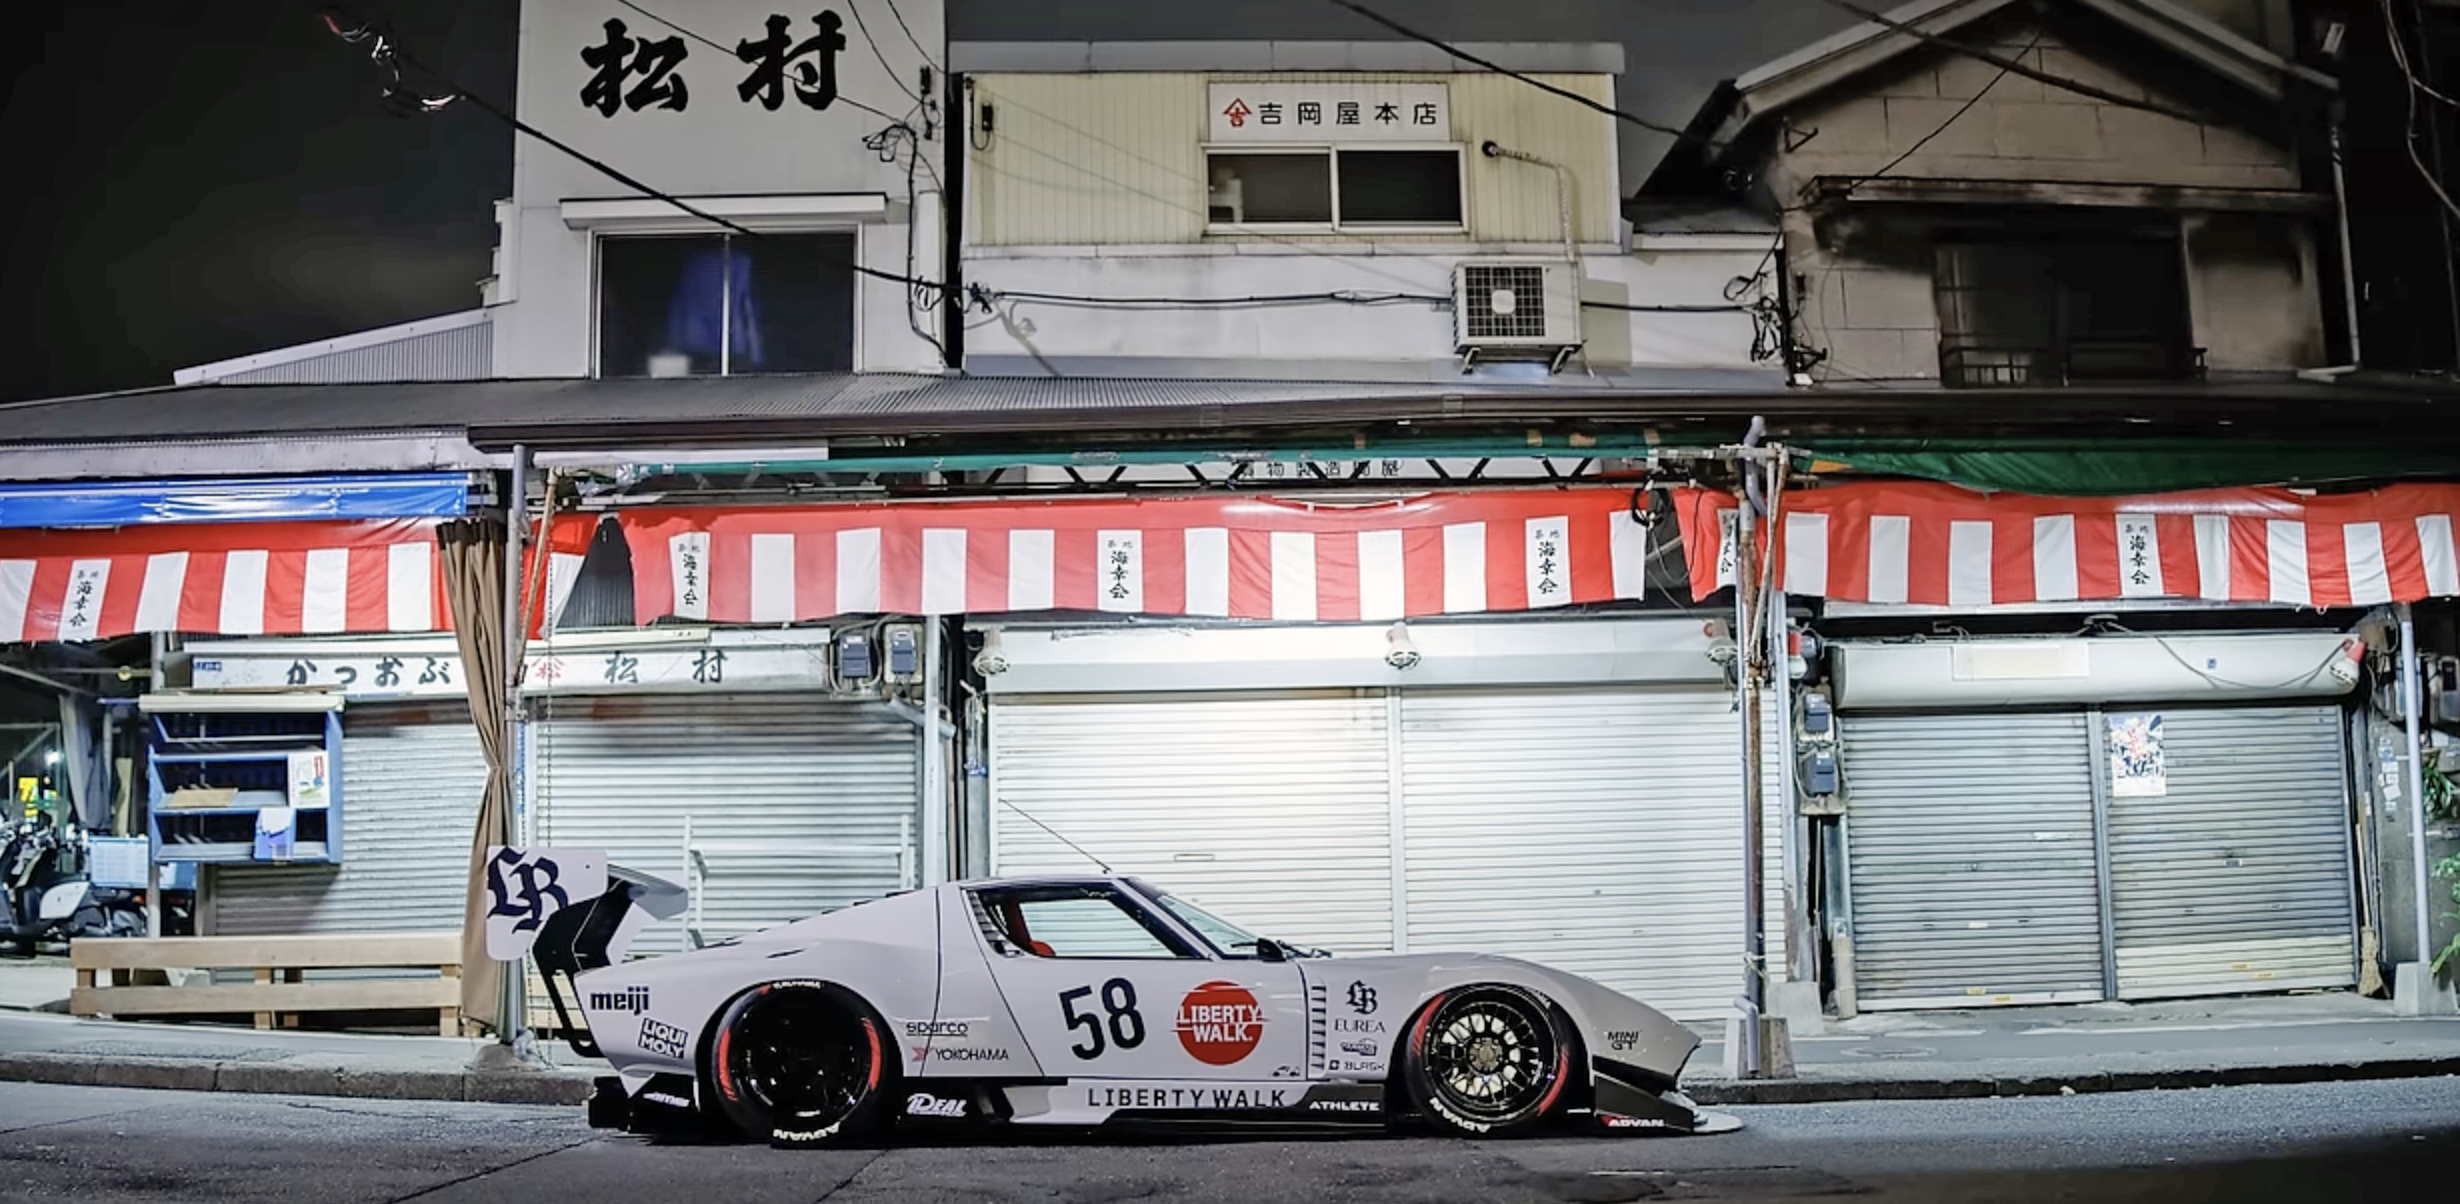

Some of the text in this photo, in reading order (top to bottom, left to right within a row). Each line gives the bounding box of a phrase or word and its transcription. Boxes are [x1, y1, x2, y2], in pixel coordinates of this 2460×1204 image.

[580, 9, 846, 118] 松村
[1258, 102, 1437, 125] 吉岡屋本店
[1109, 550, 1130, 599] 海幸会
[1537, 540, 1558, 595] 海幸会
[603, 650, 728, 684] 松村
[590, 986, 649, 1016] meiji
[1058, 977, 1146, 1061] 58
[1178, 1004, 1262, 1024] LIBERTY
[643, 1019, 687, 1046] LIQUI
[906, 1021, 969, 1036] sparco
[1333, 1018, 1386, 1033] EUREA
[1607, 1030, 1640, 1041] MINI
[640, 1034, 684, 1058] MOLY
[936, 1047, 1009, 1061] YOKOHAMA
[1611, 1040, 1637, 1050] GT
[1087, 1088, 1285, 1107] LIBERTY WALK
[1309, 1100, 1380, 1111] ATHLETE
[1608, 1118, 1665, 1127] ADVAN
